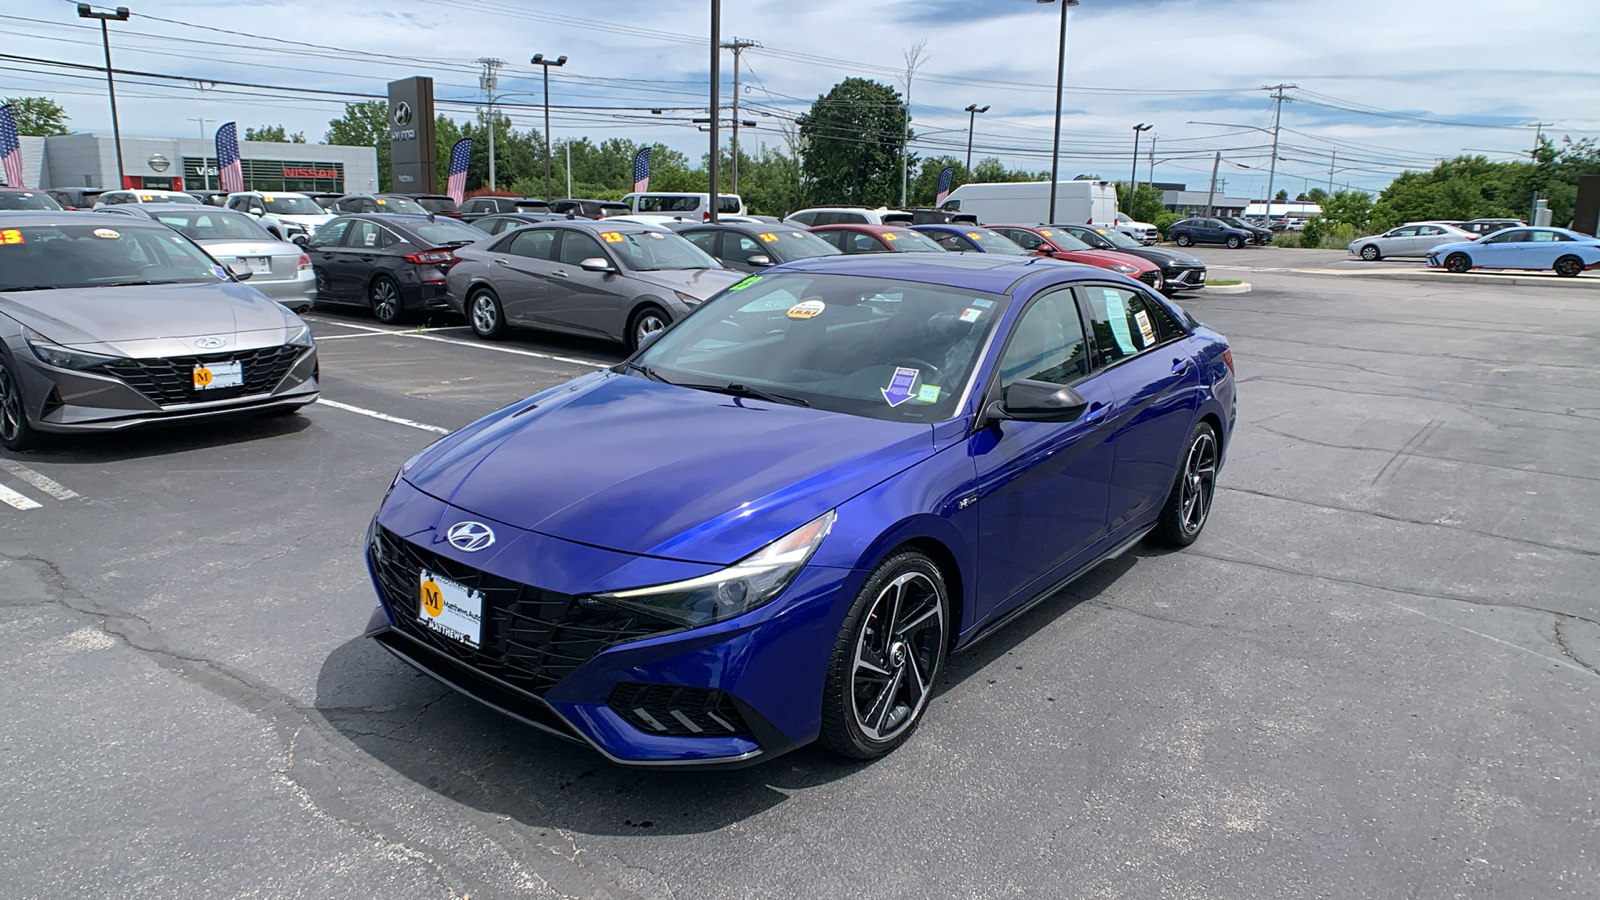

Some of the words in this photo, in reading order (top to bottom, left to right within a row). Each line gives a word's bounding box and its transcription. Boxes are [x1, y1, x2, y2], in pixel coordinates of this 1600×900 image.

[283, 167, 338, 179] NISSAN
[0, 229, 22, 245] 3
[604, 232, 623, 243] 23
[762, 232, 778, 242] 24
[197, 372, 209, 382] M
[424, 587, 440, 610] M
[443, 599, 469, 617] Matthews
[427, 620, 466, 643] MATTHEWS
